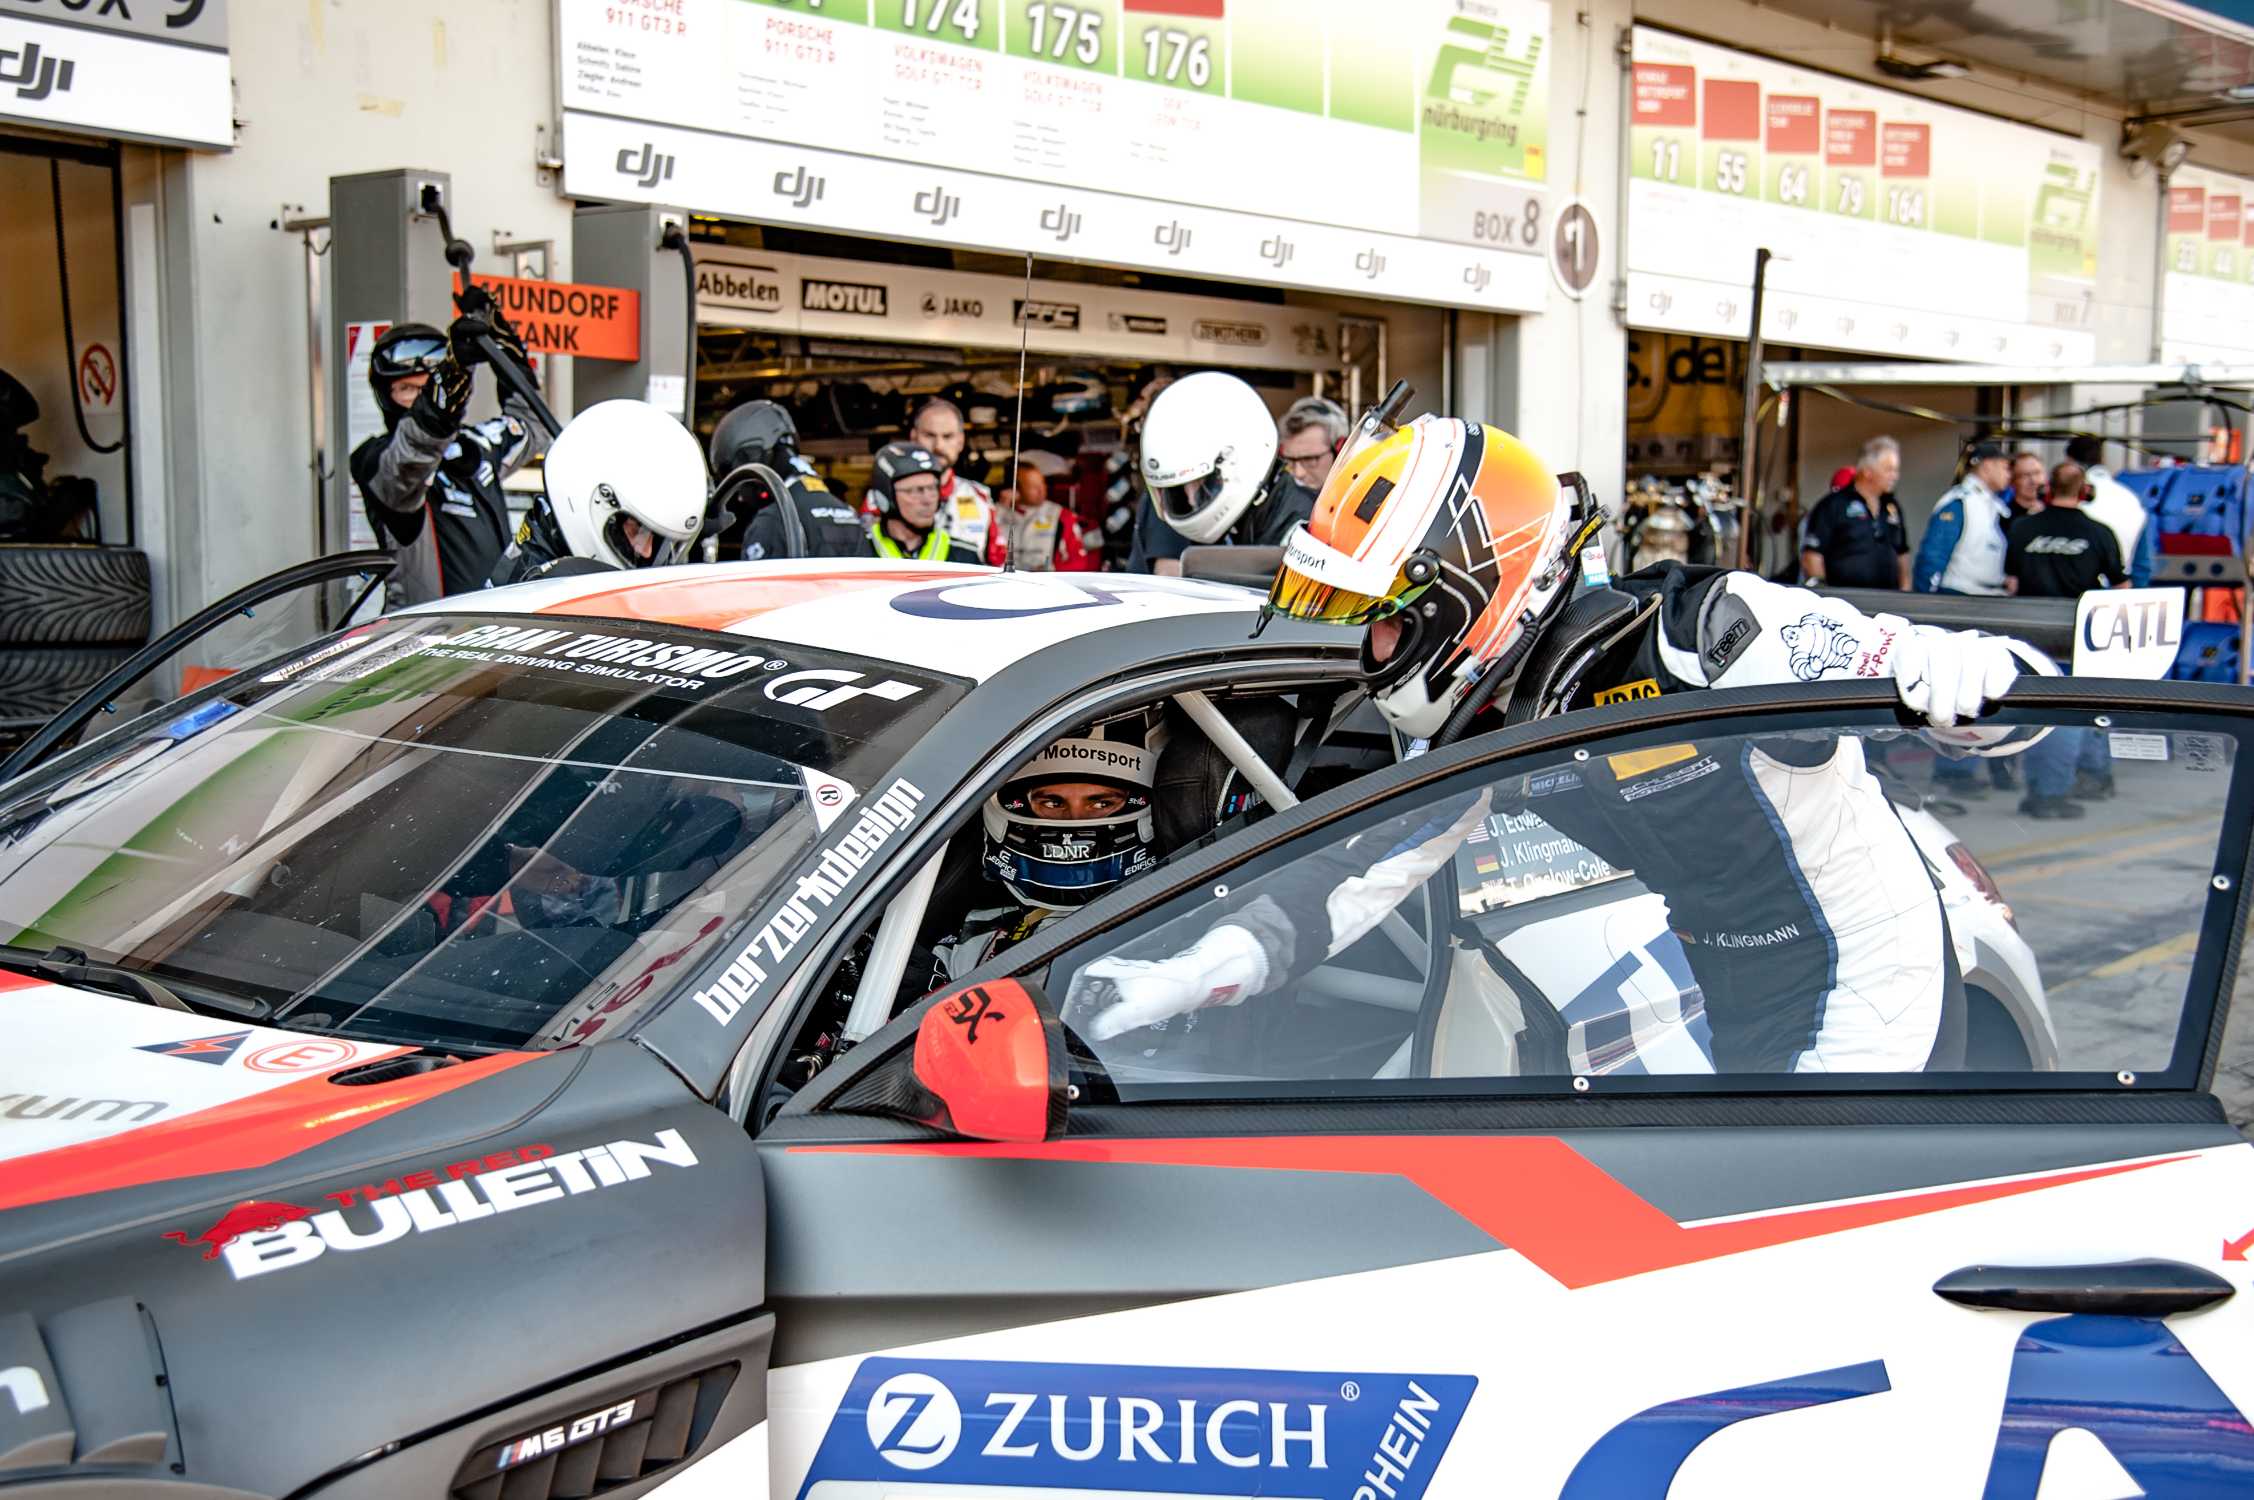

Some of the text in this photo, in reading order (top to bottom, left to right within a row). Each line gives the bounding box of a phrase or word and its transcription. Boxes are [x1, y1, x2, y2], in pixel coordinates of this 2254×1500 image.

[1027, 2, 1103, 65] 175
[1143, 28, 1211, 87] 176
[1423, 103, 1518, 147] nürburgring
[1652, 137, 1680, 181] 11
[1716, 149, 1746, 194] 55
[1778, 163, 1809, 206] 64
[1838, 173, 1865, 216] 79
[1887, 186, 1925, 225] 164
[1472, 198, 1542, 246] BOX 8
[697, 272, 780, 303] Abbelen
[803, 281, 887, 315] MOTUL
[2083, 601, 2179, 656] CATL
[446, 624, 766, 679] GRAN TURISMO
[450, 649, 496, 662] REAL
[495, 653, 578, 672] DRIVING
[575, 662, 706, 691] SIMULATOR
[1044, 744, 1142, 771] Motorsport
[692, 777, 926, 1027] berzerkdesign
[1716, 923, 1800, 949] KLINGMANN
[323, 1143, 556, 1208] THE RED
[223, 1128, 700, 1280] BULLETIN
[517, 1399, 636, 1461] M6 GT3
[980, 1391, 1330, 1471] ZURICH
